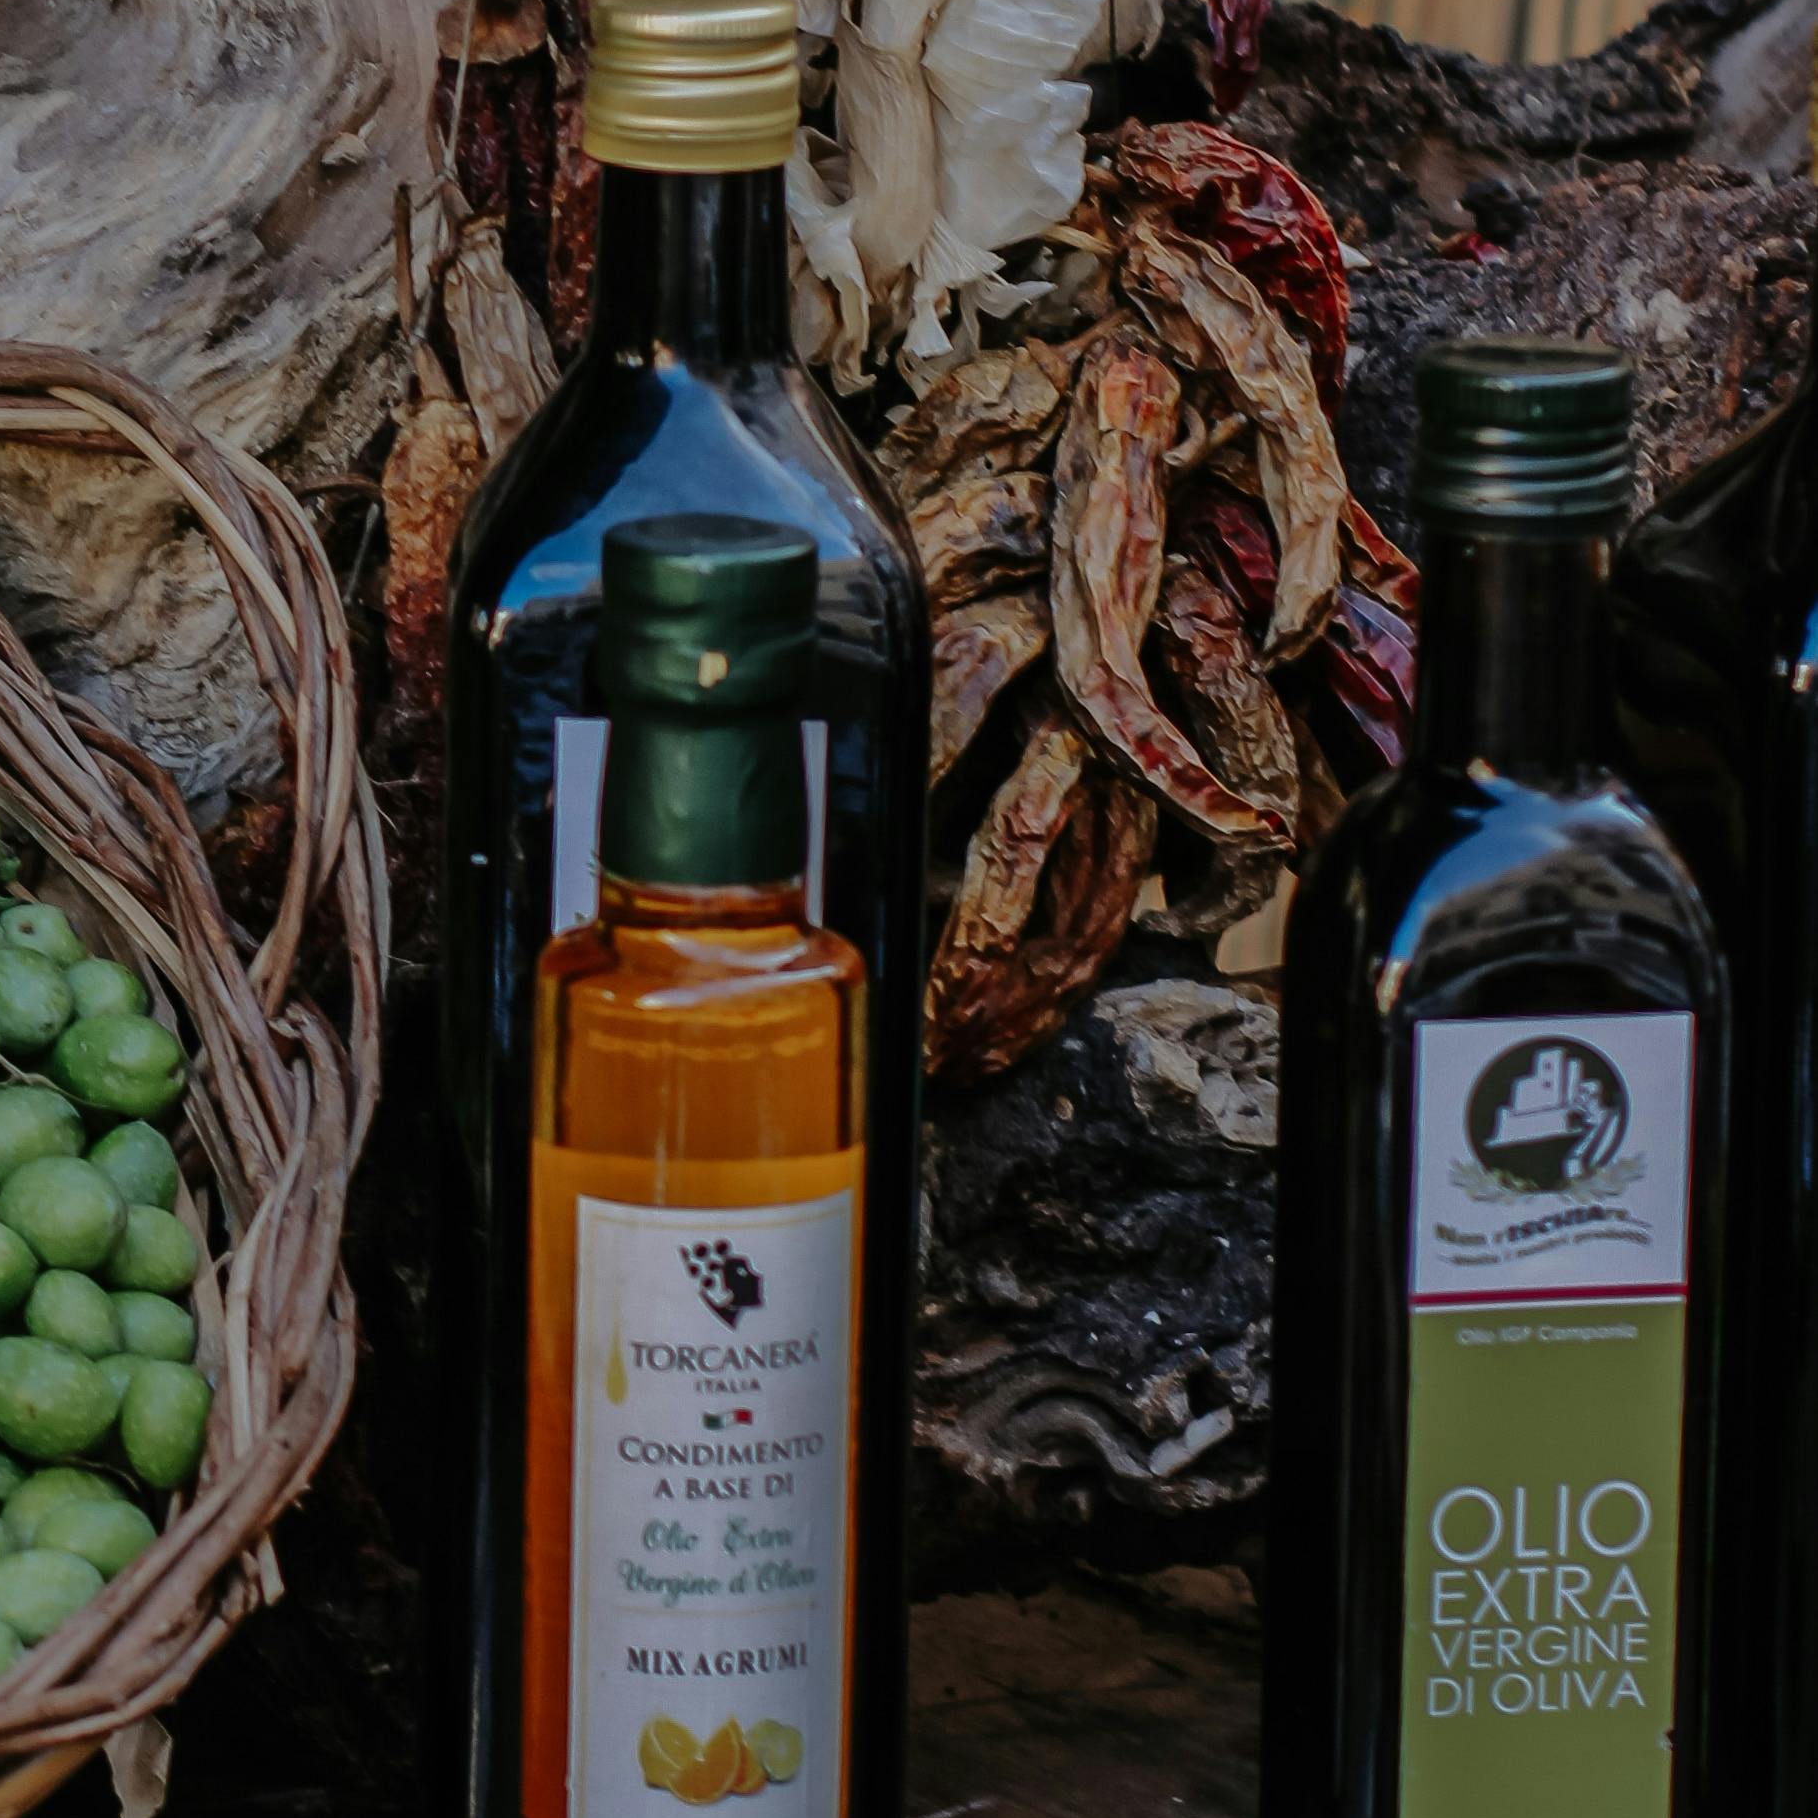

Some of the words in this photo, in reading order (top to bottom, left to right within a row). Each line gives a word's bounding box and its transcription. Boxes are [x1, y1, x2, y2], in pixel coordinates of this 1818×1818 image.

[695, 1378, 762, 1394] ITALIA
[653, 1477, 675, 1499] A
[685, 1476, 752, 1500] BASE
[764, 1472, 794, 1497] DI
[1429, 1479, 1653, 1564] OLIO
[1430, 1563, 1650, 1626] EXTRA
[627, 1645, 686, 1675] MIX
[693, 1641, 808, 1676] AGRUMI
[1429, 1622, 1648, 1669] VERGINE
[1428, 1676, 1475, 1717] DI
[1490, 1669, 1646, 1715] OLIVA
